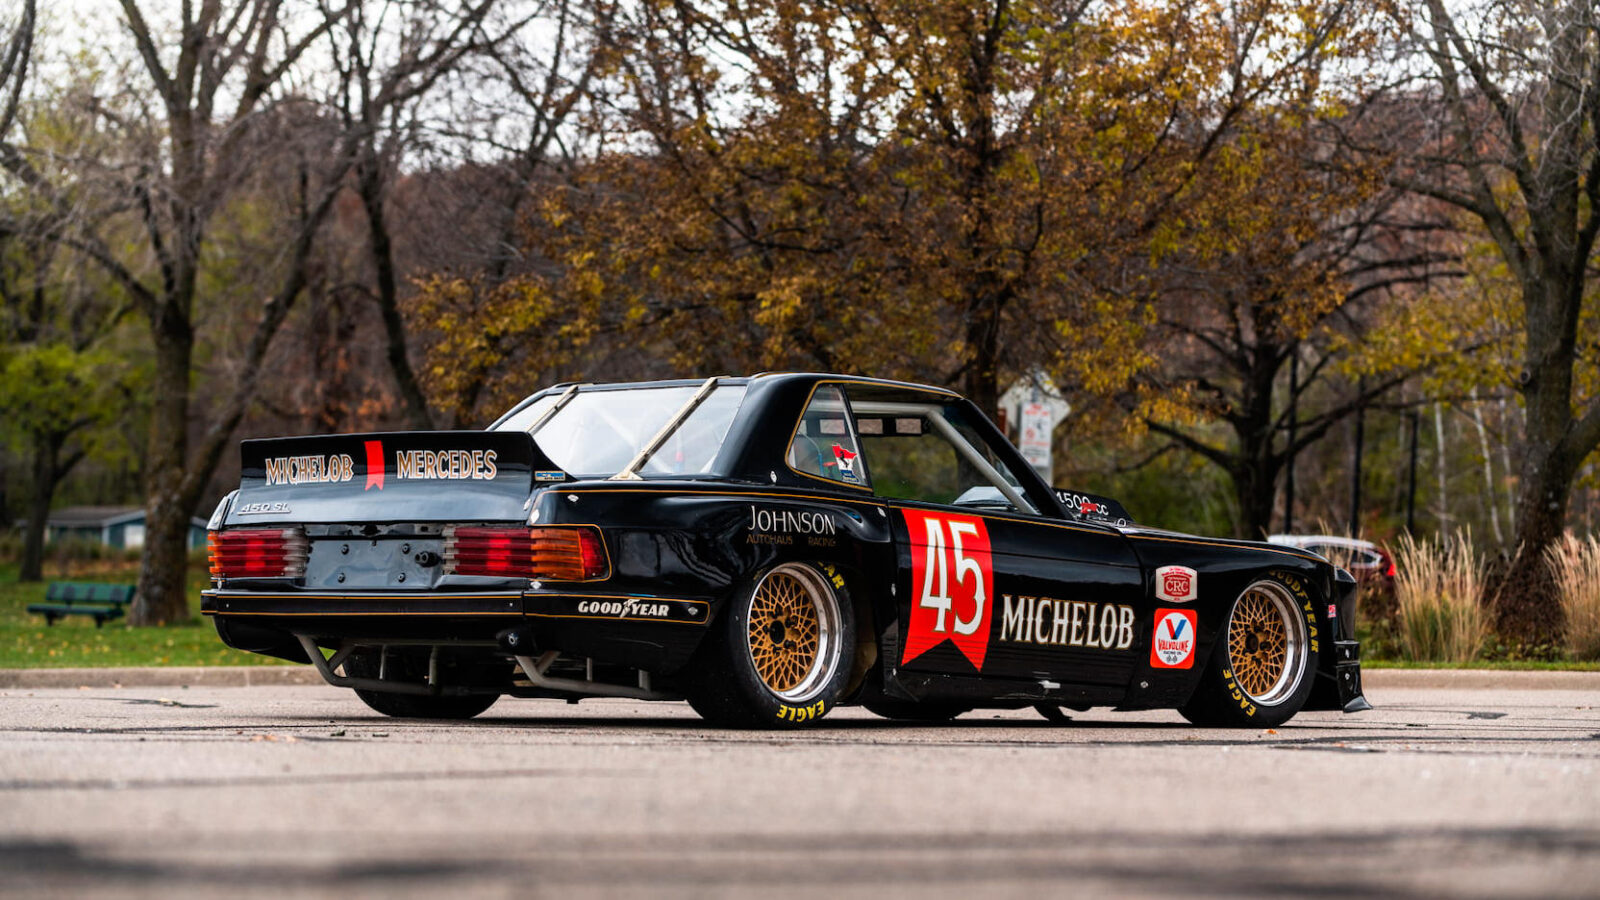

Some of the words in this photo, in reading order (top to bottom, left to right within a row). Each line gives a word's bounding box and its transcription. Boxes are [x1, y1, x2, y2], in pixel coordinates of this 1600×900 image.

[265, 454, 354, 486] MICHELOB
[396, 449, 498, 480] MERCEDES
[240, 502, 272, 512] 450
[273, 502, 290, 511] SL
[747, 505, 836, 535] JOHNSON
[746, 533, 793, 545] AUTOHAUS
[919, 517, 986, 636] 45
[1165, 580, 1189, 592] CRC
[577, 598, 670, 617] GOODYEAR
[999, 594, 1136, 650] MICHELOB
[1158, 638, 1190, 653] VALVOLINE
[1223, 669, 1257, 717] EAGLE
[776, 699, 825, 722] EAGLE
